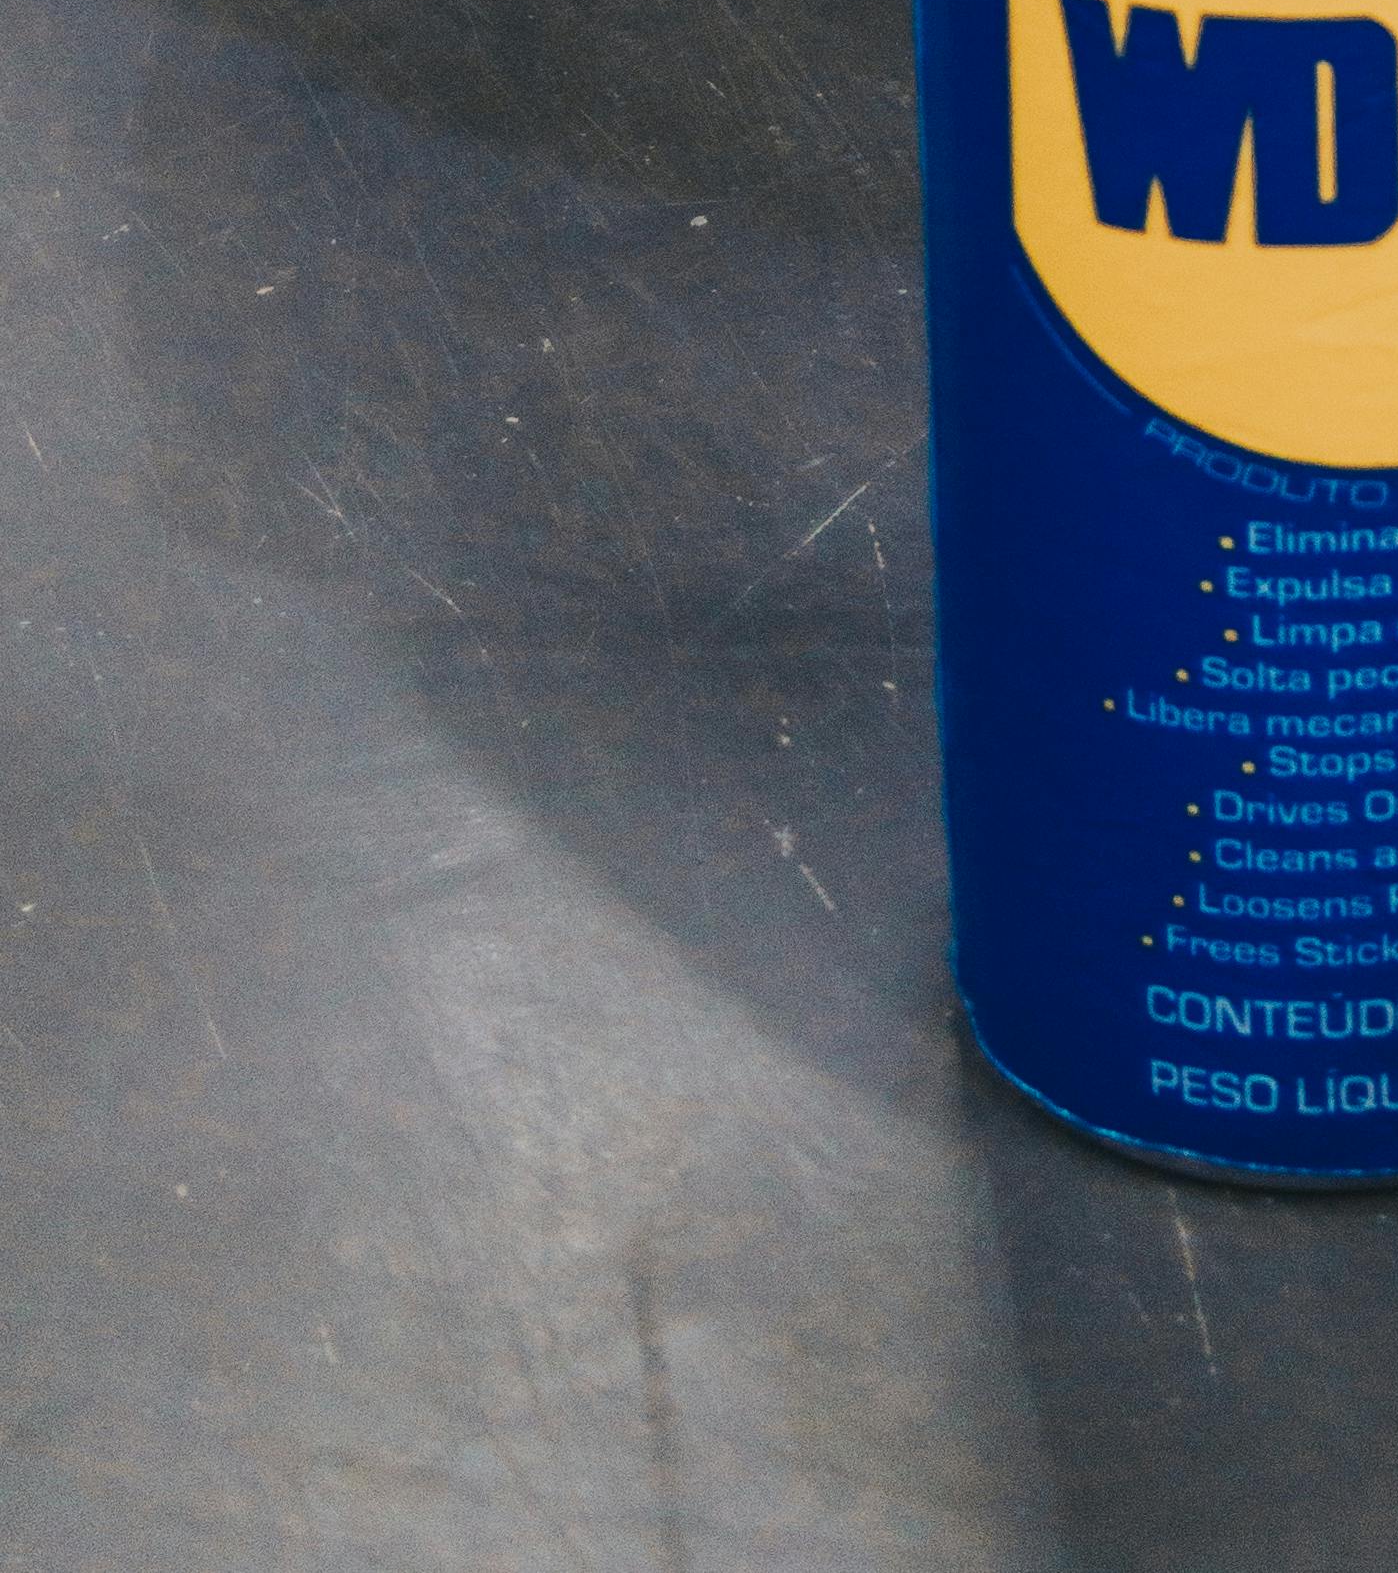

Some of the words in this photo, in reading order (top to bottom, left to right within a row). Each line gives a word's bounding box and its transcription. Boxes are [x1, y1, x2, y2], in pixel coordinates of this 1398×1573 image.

[1143, 416, 1390, 509] PRODUTO
[1226, 565, 1393, 607] Expulsa
[1251, 614, 1383, 653] Limpa
[1201, 655, 1312, 692] Solta
[1126, 687, 1250, 735] Libera
[1268, 745, 1397, 783] Stops
[1213, 788, 1349, 826] Drives
[1214, 837, 1359, 873] Cleans
[1198, 882, 1374, 920] Loosens
[1165, 923, 1282, 967] Frees
[1149, 1058, 1280, 1114] PESO
